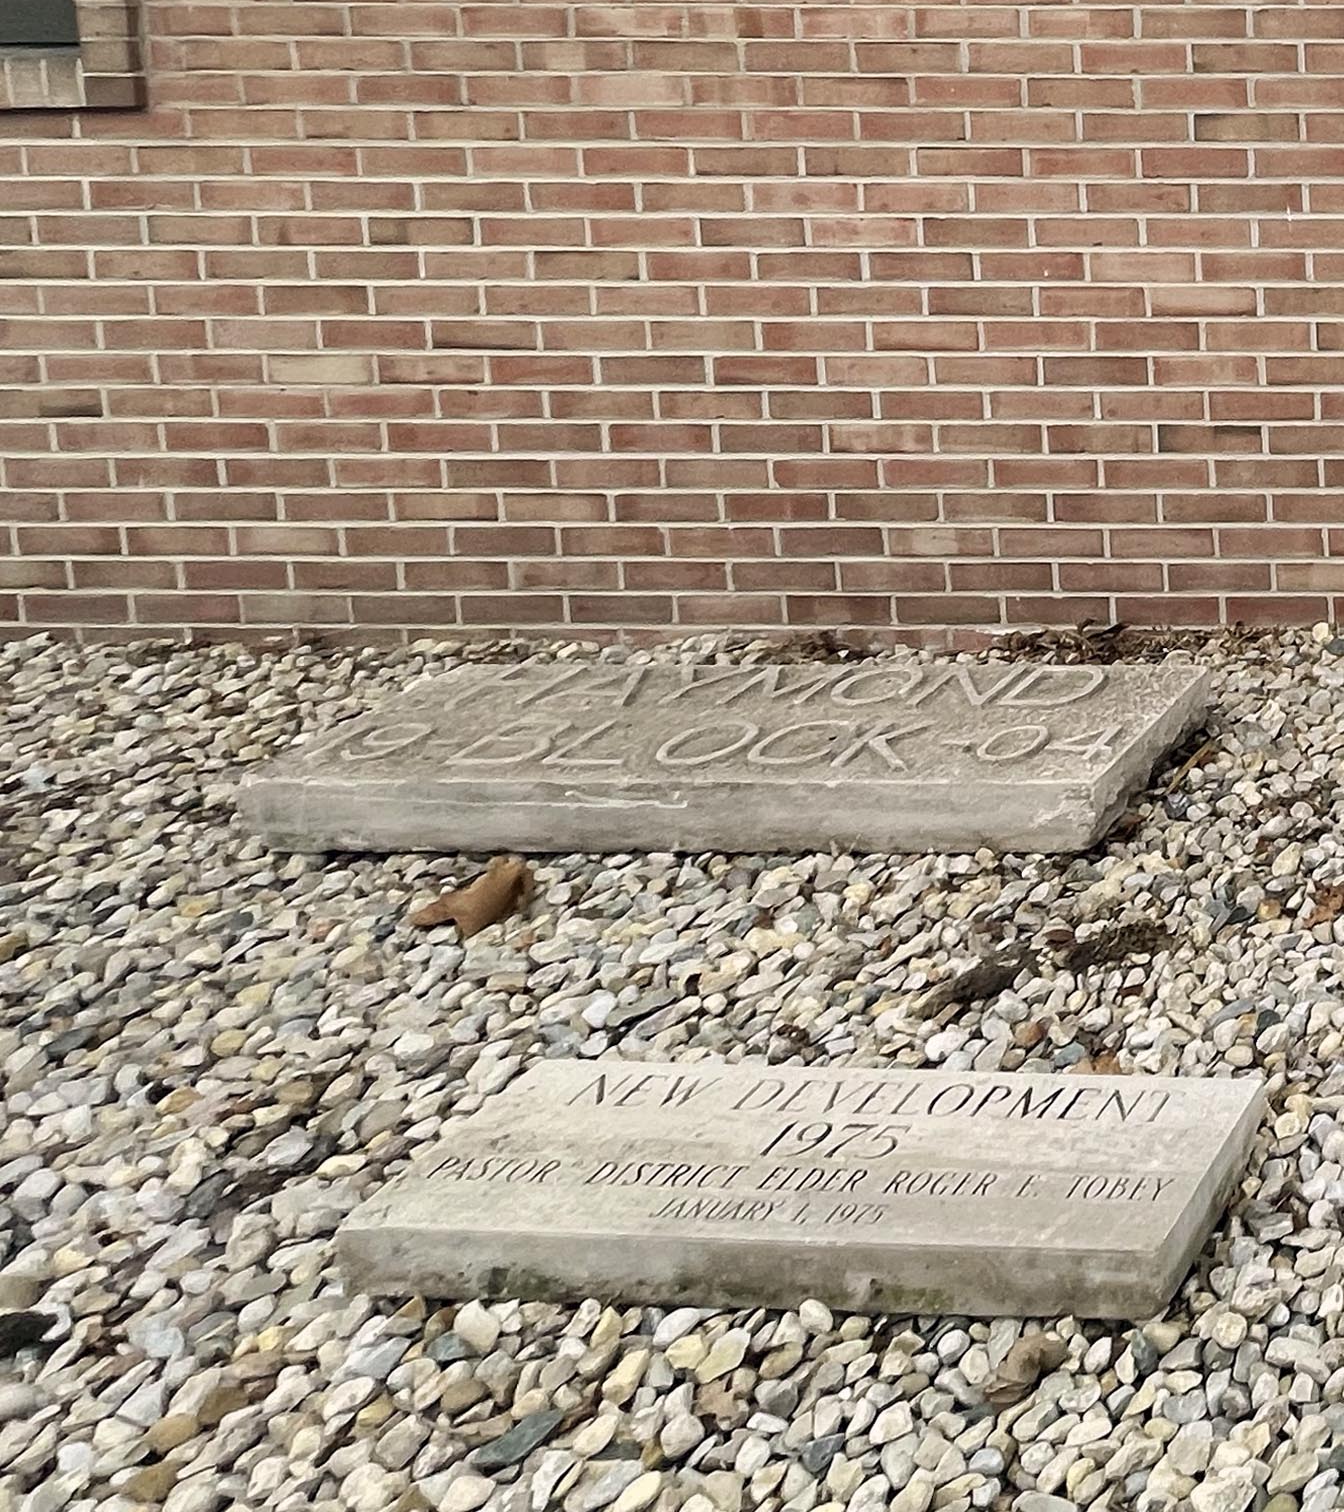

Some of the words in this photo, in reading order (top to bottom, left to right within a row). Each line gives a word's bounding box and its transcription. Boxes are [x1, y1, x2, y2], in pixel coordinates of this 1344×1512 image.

[567, 1073, 724, 1108] NEW
[731, 1078, 1183, 1123] DEVELOPMENT
[759, 1119, 913, 1160] 1975
[427, 1155, 562, 1185] PASTOR
[583, 1160, 750, 1189] DISTRICT
[756, 1165, 869, 1193] ELDER
[882, 1169, 999, 1197] ROGER
[1015, 1174, 1041, 1199] E.
[1065, 1174, 1177, 1202] TOBEY
[648, 1196, 786, 1222] JANUARY
[791, 1201, 811, 1225] 1,
[824, 1202, 891, 1225] 1975
